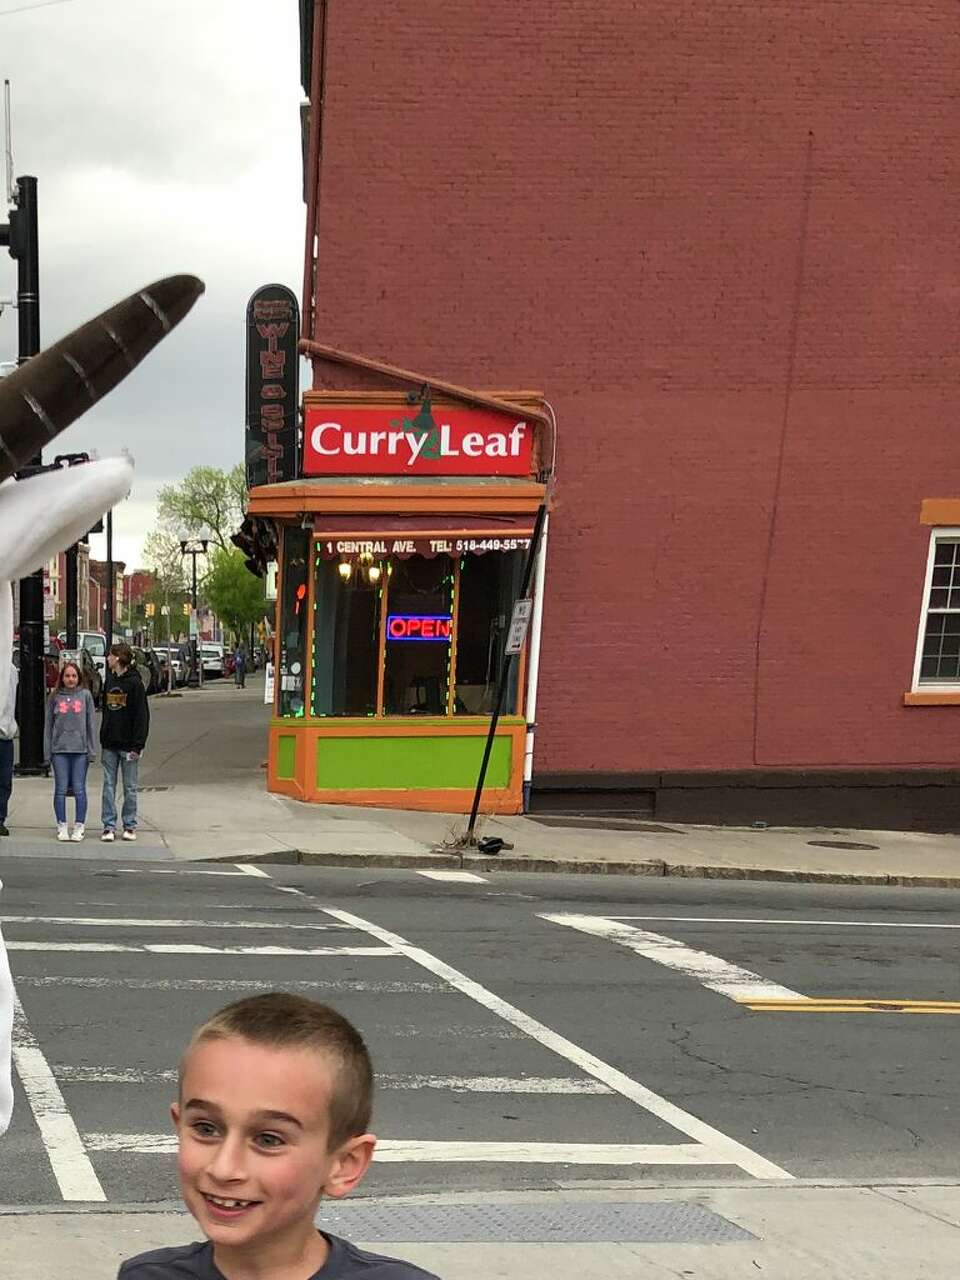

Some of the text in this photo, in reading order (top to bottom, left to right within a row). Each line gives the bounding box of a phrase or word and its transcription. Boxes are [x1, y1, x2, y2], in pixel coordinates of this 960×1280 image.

[310, 421, 526, 465] Curry Leaf
[326, 541, 333, 553] 1
[336, 541, 387, 553] CENTRAL
[392, 540, 416, 553] AVE.
[429, 540, 452, 552] TEL:
[390, 619, 450, 637] OPEN
